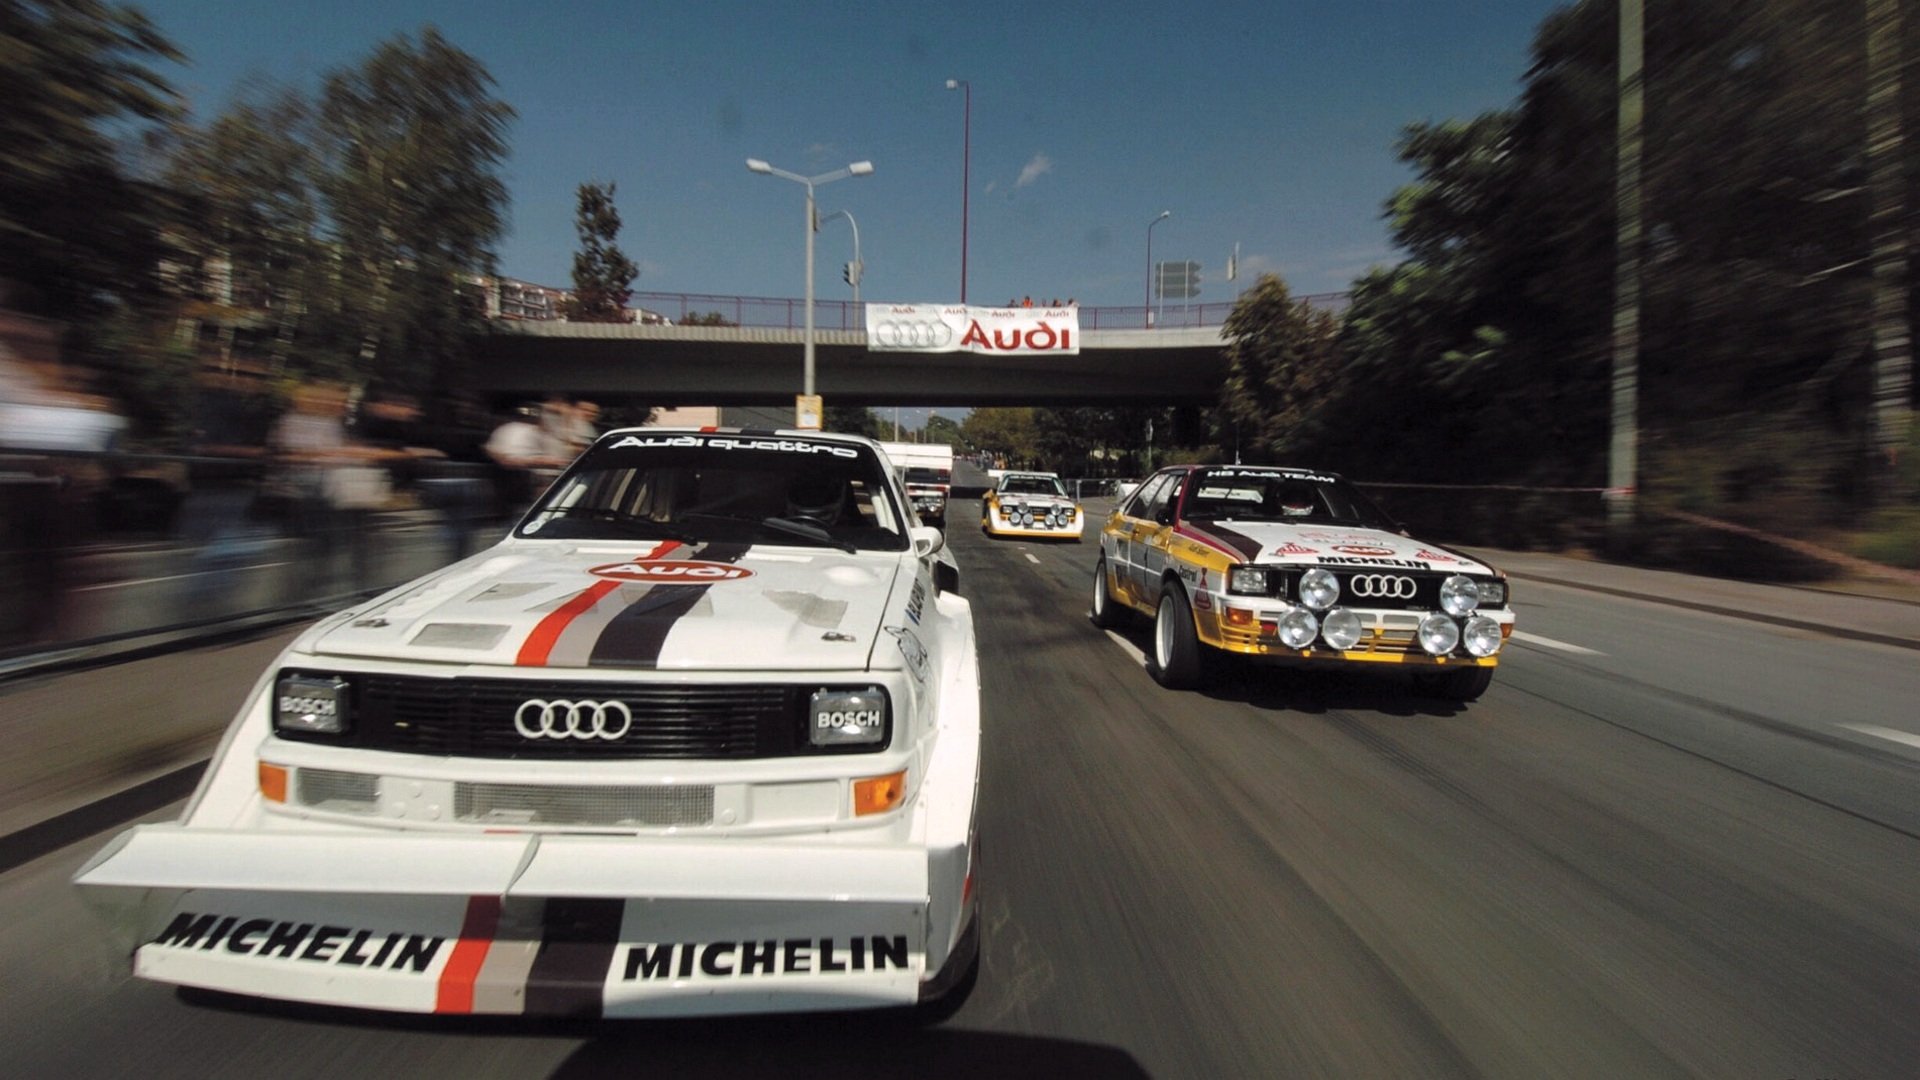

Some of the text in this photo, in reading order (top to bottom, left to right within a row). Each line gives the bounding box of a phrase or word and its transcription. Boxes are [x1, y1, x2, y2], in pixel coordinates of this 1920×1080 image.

[961, 318, 1070, 350] Audi
[609, 436, 858, 458] Audi quattro
[1282, 472, 1335, 483] TEAM
[1317, 556, 1431, 570] MICHELIN
[280, 696, 336, 715] BOSCH
[817, 710, 880, 728] BOSCH
[155, 912, 445, 973] MICHELIN
[622, 935, 909, 981] MICHELIN
